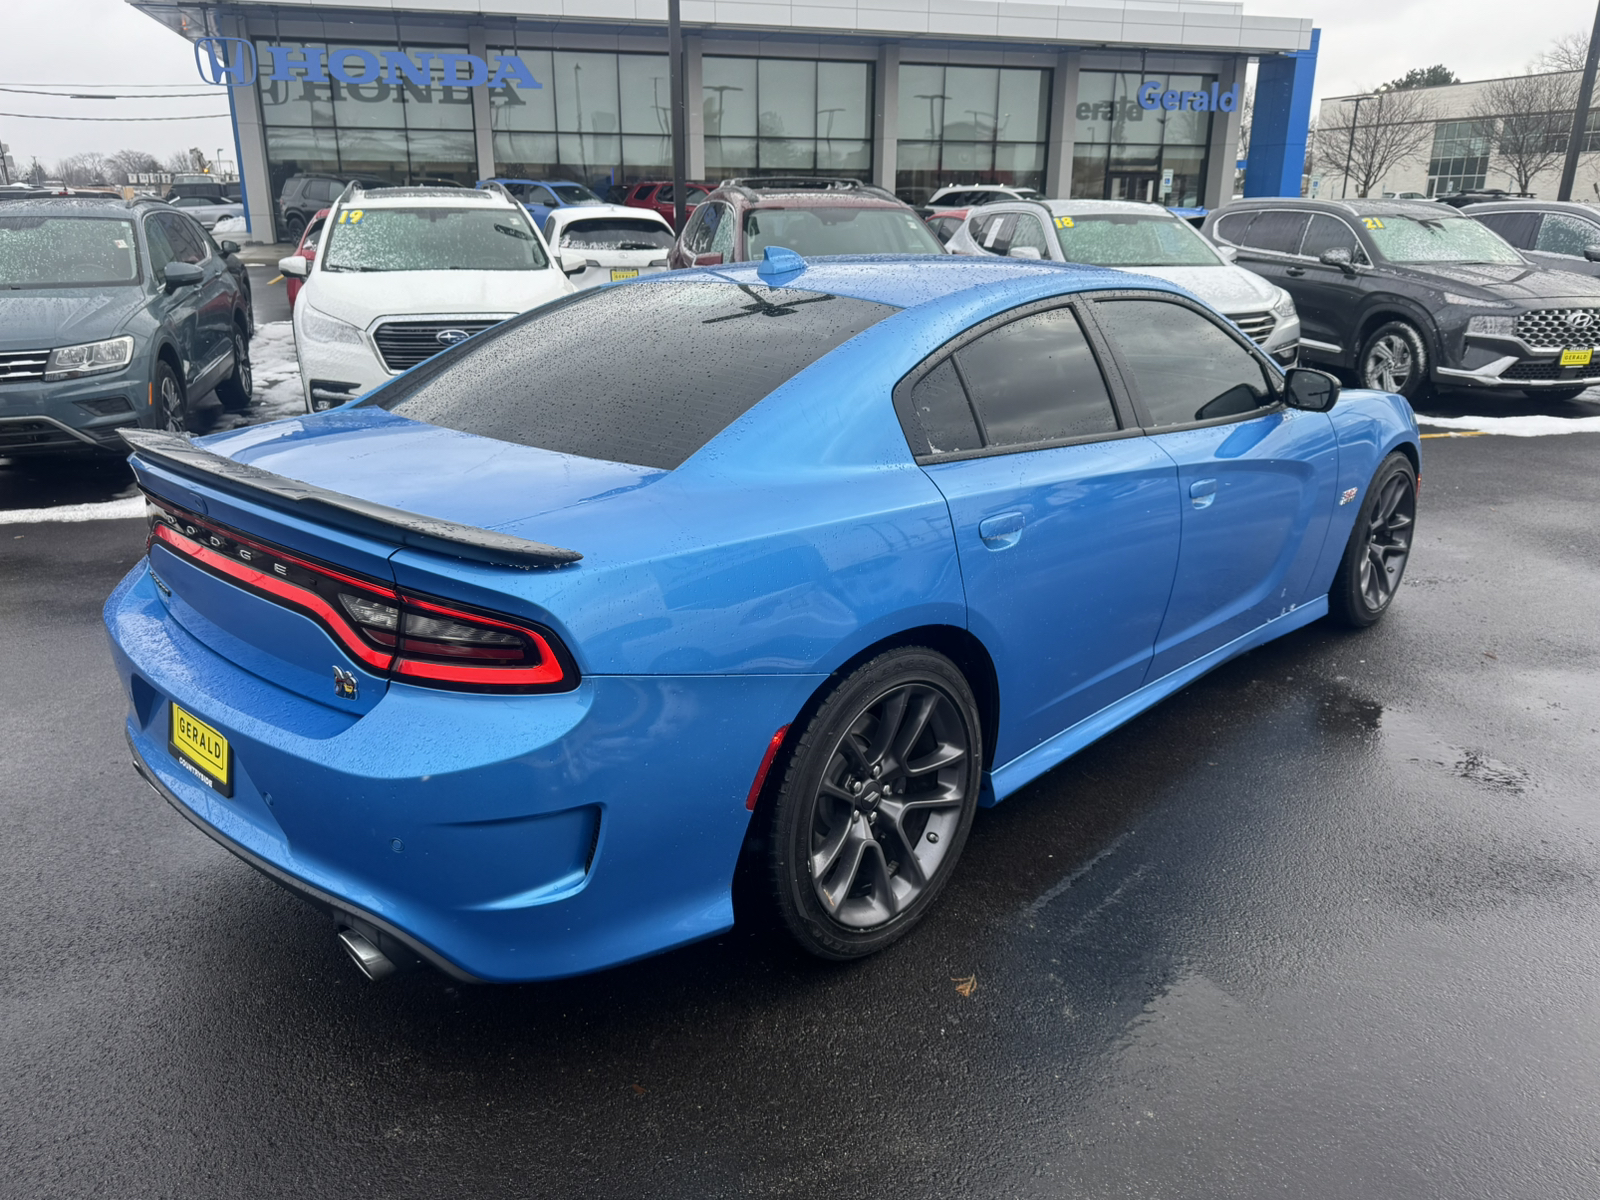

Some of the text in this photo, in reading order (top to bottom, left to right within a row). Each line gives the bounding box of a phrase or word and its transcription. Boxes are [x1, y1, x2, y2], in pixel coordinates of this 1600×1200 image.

[266, 46, 543, 89] HONDA
[1137, 80, 1240, 112] Gerald
[338, 209, 364, 225] 19
[1053, 216, 1075, 230] 18
[1361, 217, 1385, 230] 21
[166, 513, 287, 576] DODGE
[179, 717, 221, 759] GERALD
